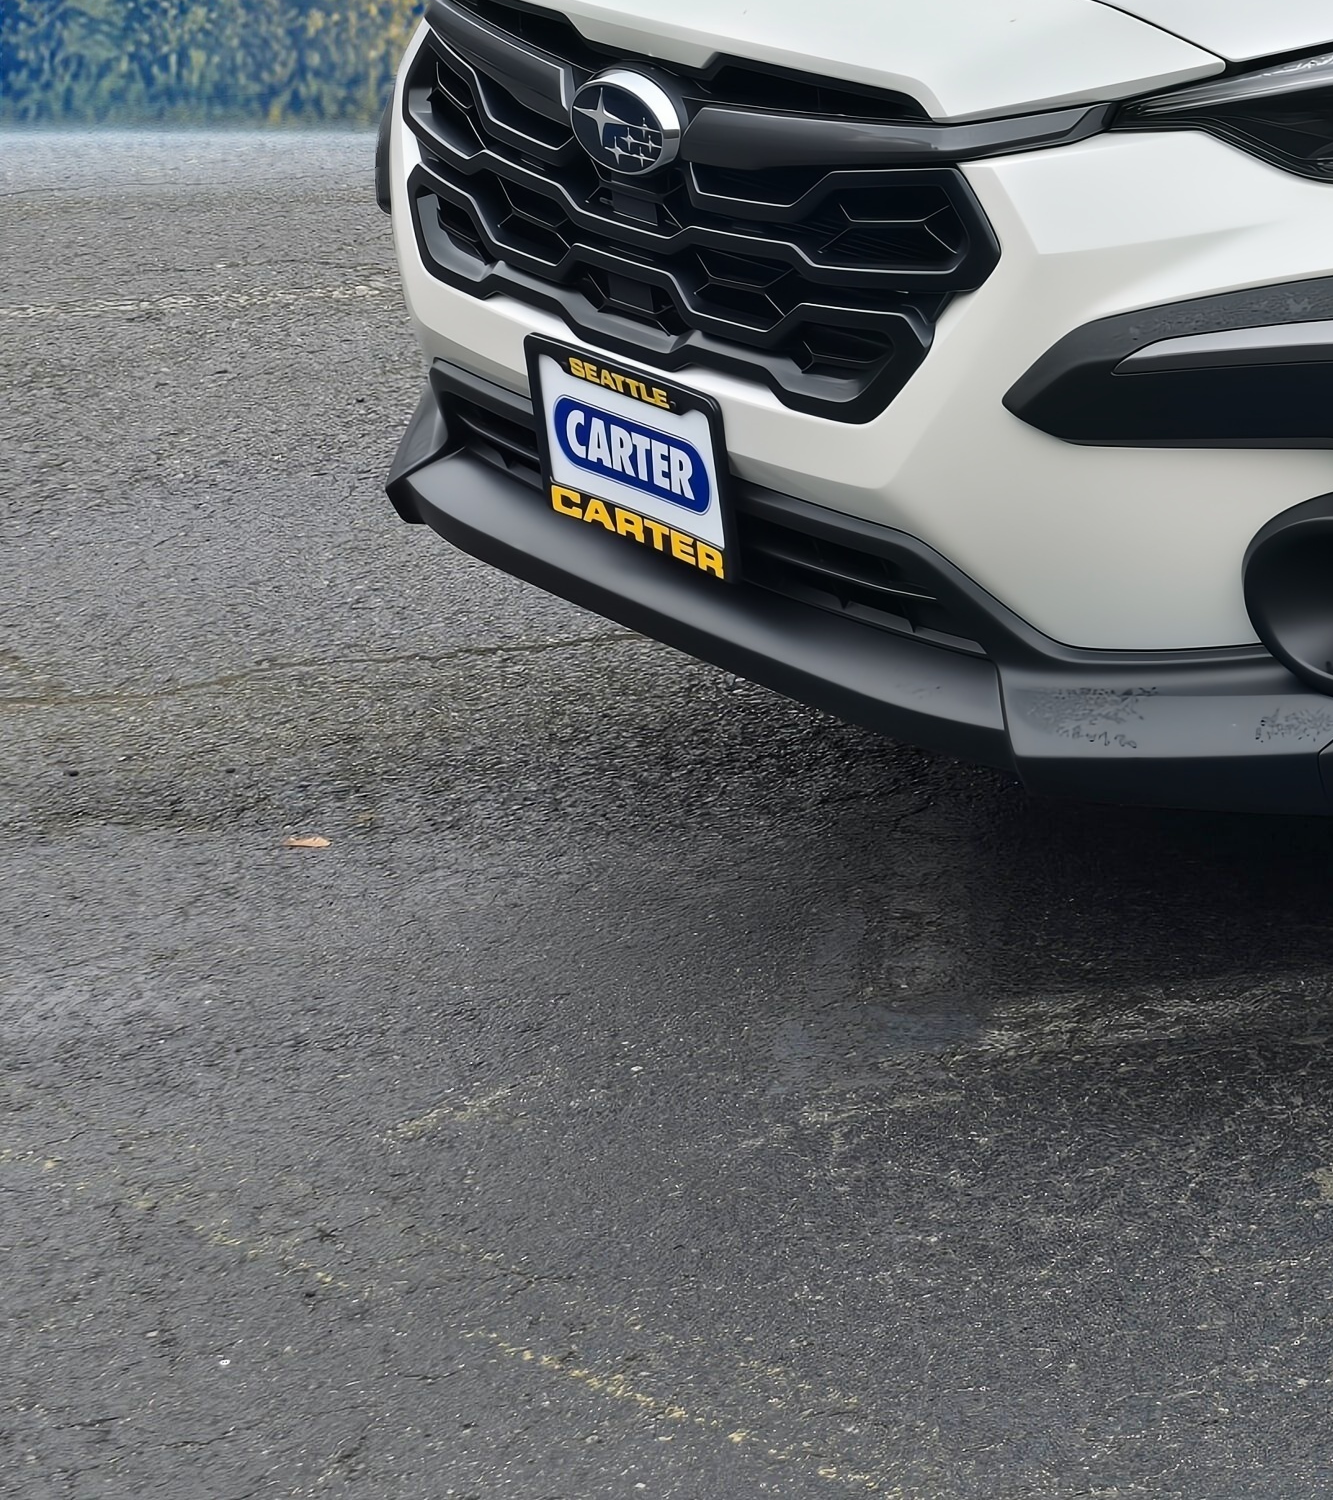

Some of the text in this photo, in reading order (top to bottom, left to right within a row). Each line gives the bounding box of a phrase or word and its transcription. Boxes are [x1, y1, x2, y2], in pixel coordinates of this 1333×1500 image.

[568, 357, 671, 409] SEATTLE
[565, 409, 696, 501] CARTER
[551, 484, 725, 580] CARTER
